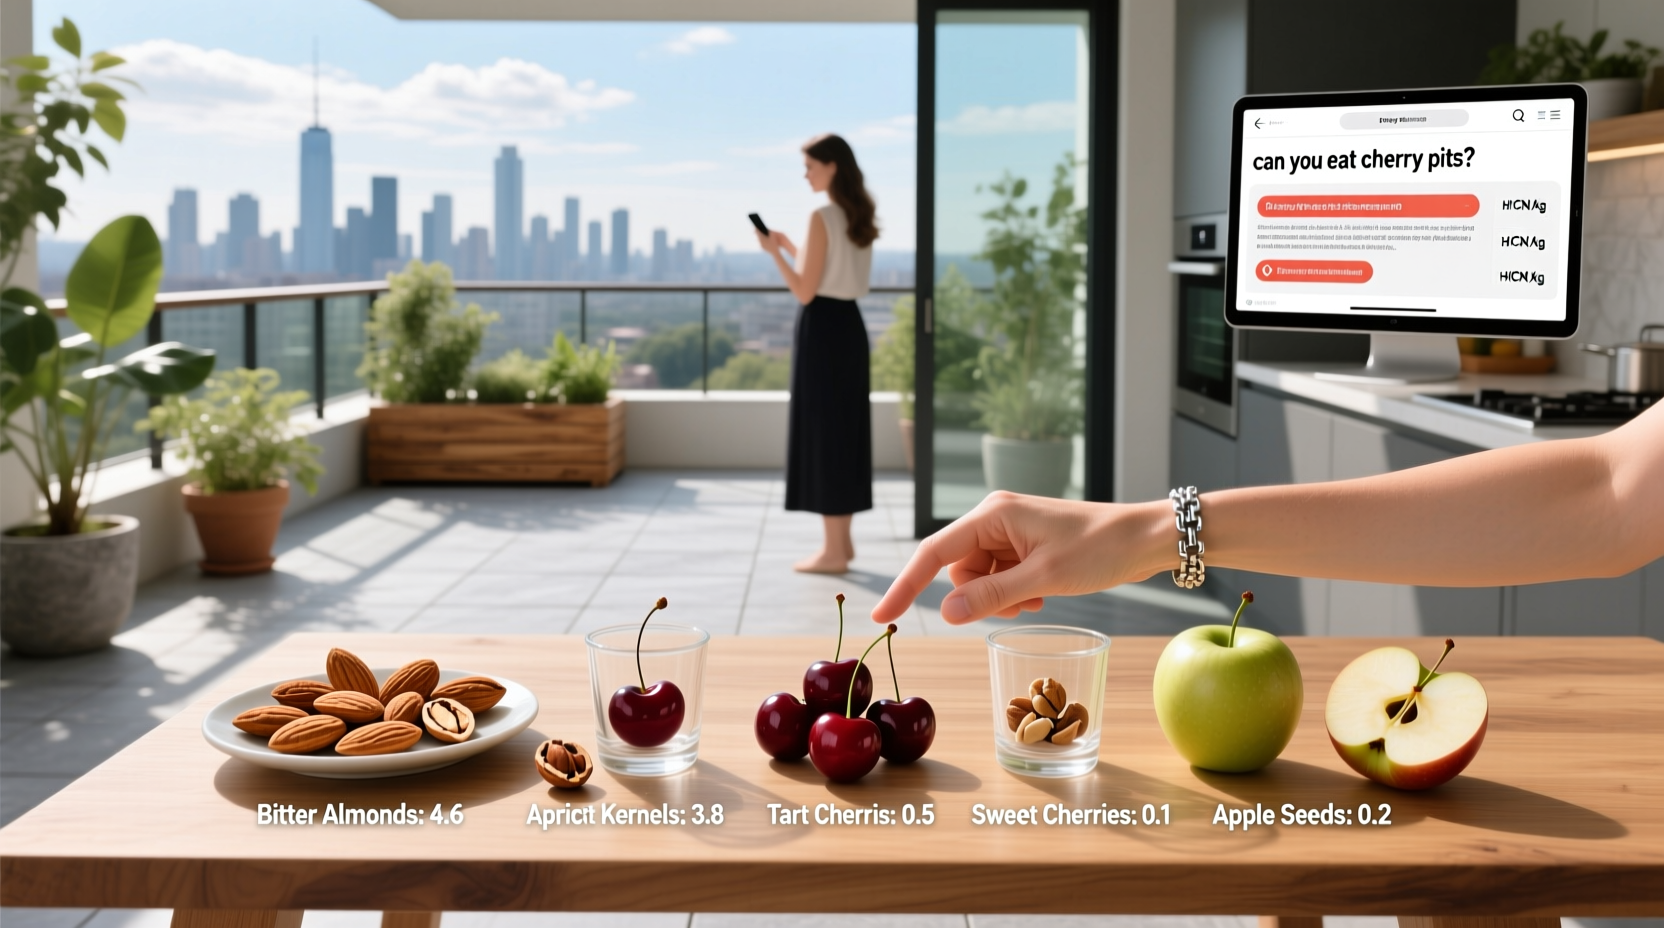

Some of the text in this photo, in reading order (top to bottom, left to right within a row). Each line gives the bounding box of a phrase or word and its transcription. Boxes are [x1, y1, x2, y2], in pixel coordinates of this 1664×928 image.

[1252, 146, 1476, 175] can you eat cherry pits?
